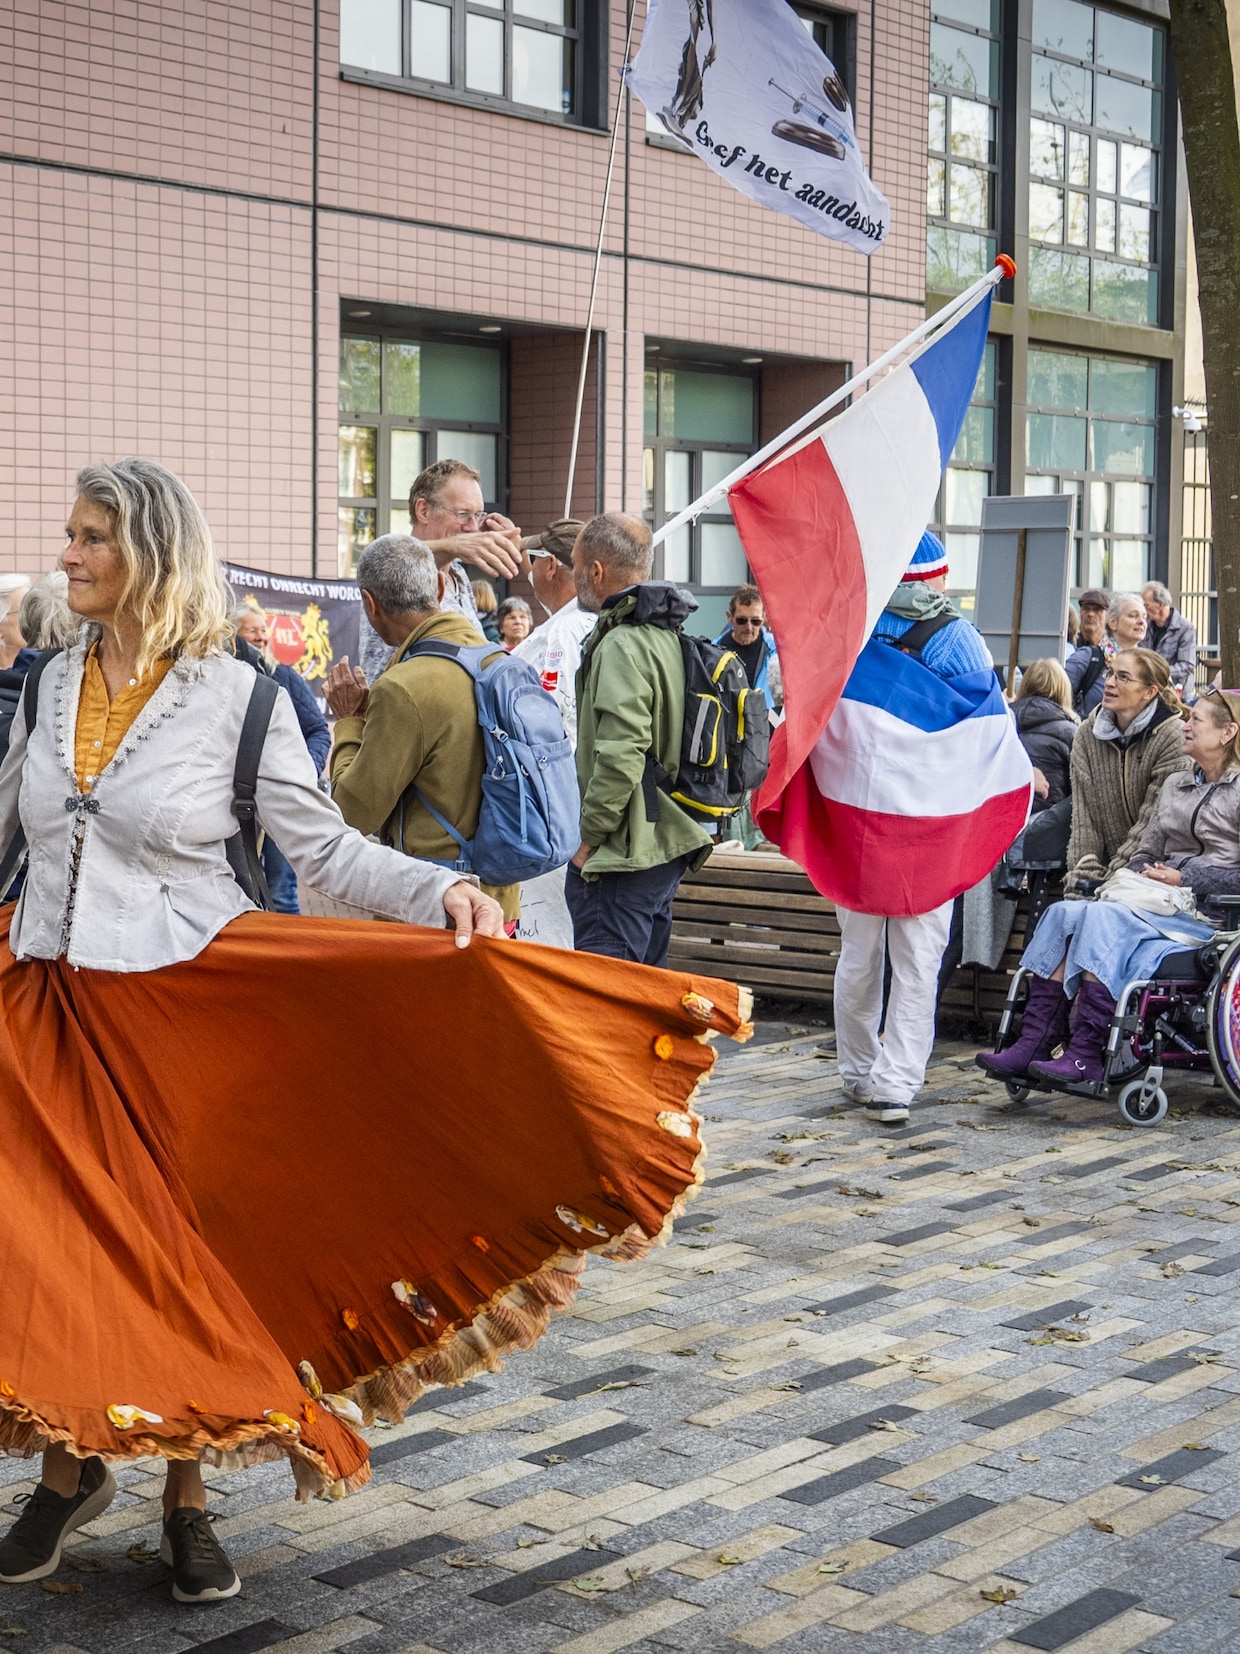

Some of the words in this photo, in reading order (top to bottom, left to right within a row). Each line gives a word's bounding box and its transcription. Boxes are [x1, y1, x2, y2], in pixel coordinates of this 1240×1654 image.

[744, 153, 793, 191] het
[794, 183, 885, 242] aandacht
[229, 569, 268, 588] RECHT
[270, 578, 326, 598] ONRECHT
